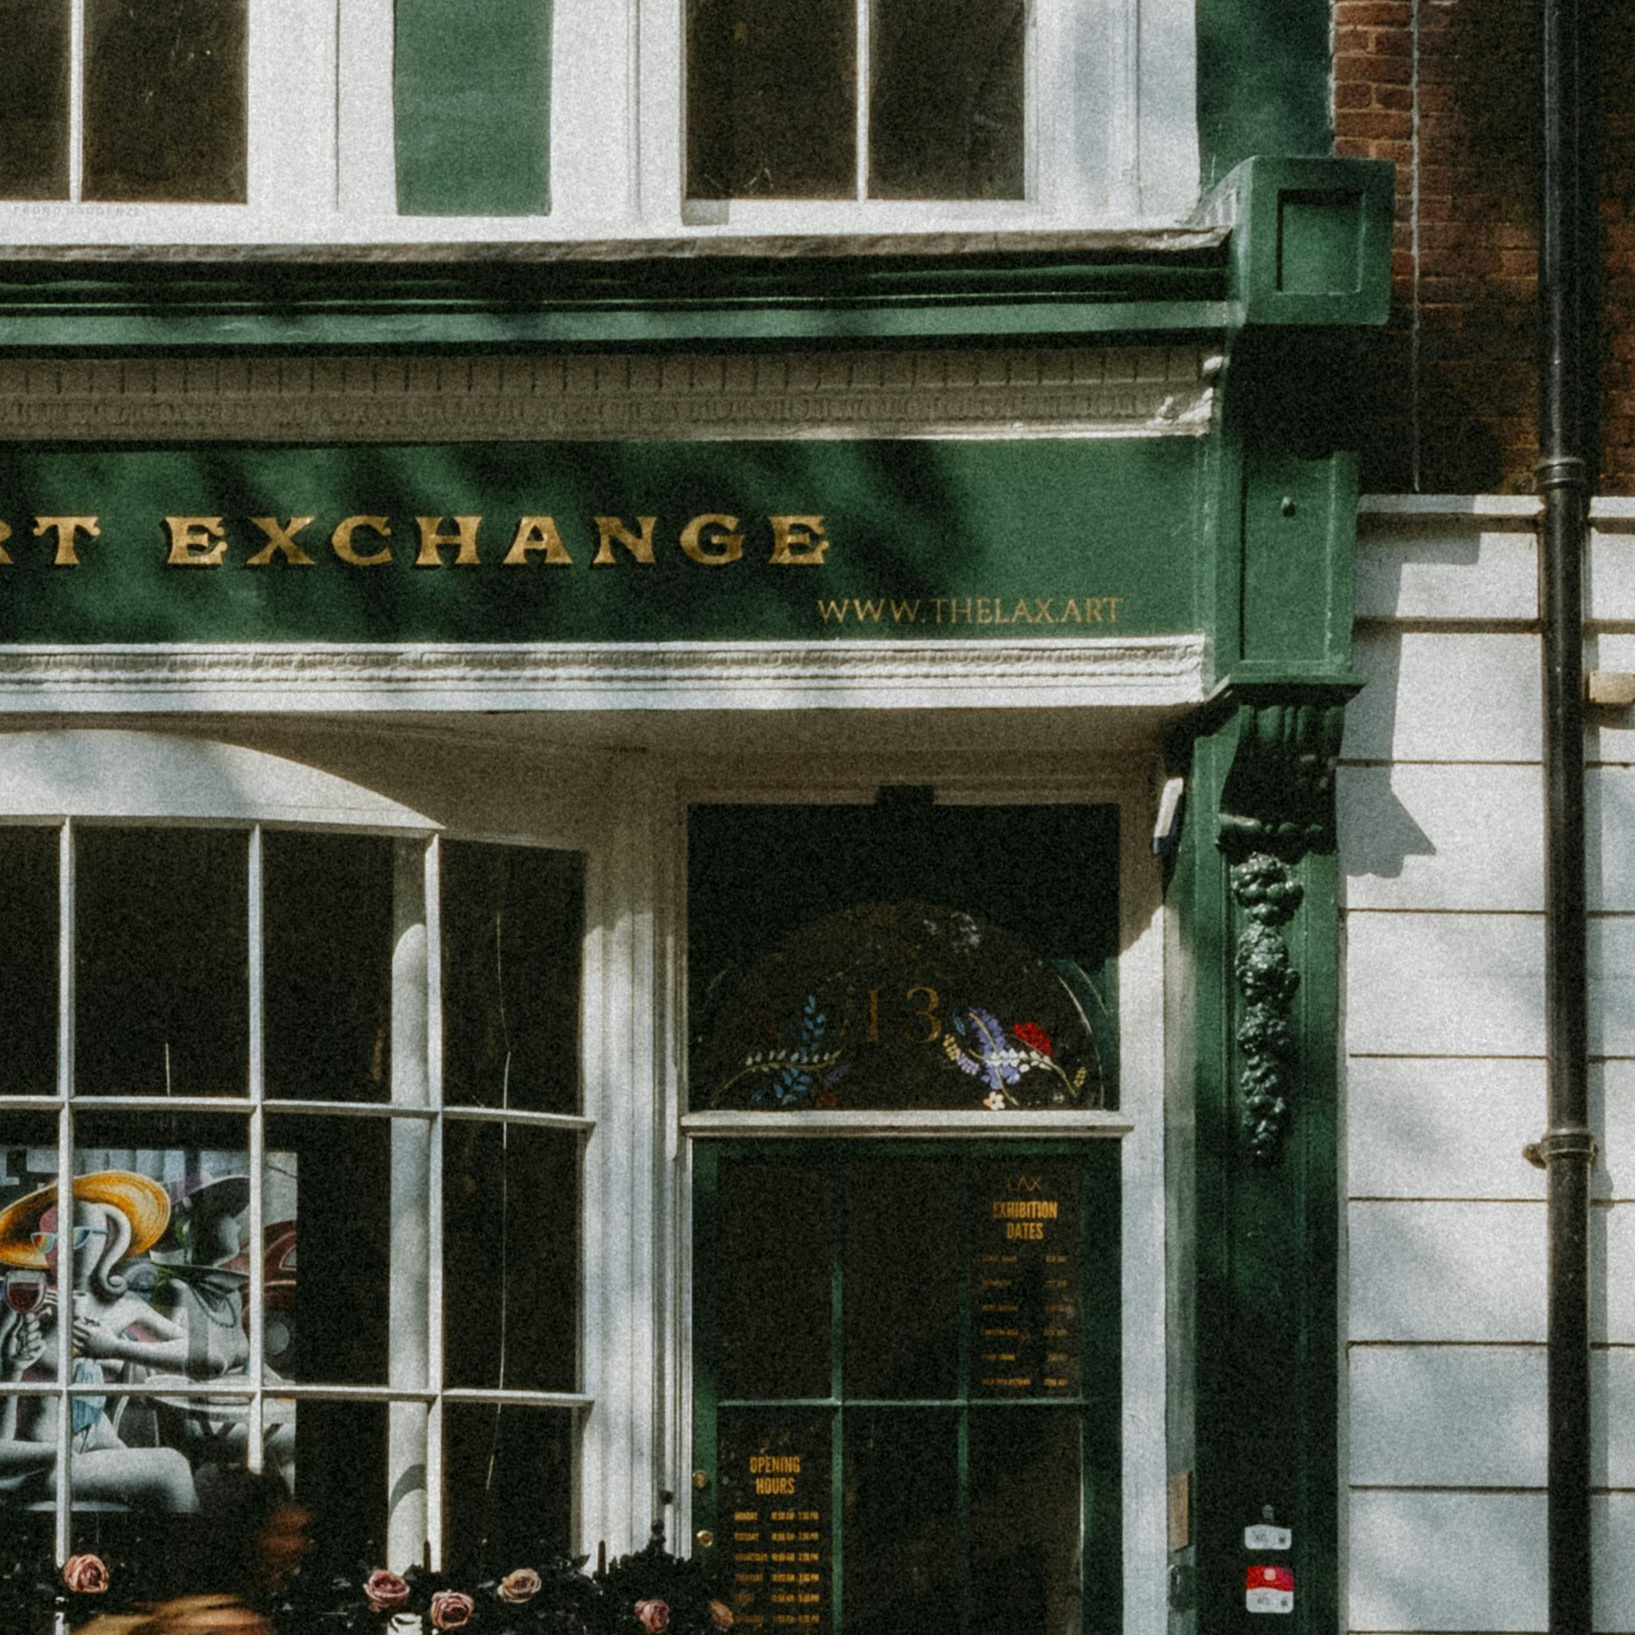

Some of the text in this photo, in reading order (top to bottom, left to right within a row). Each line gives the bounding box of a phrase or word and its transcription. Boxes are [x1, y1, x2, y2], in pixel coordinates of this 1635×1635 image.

[166, 513, 830, 566] EXCHANGE
[817, 597, 1123, 624] WWW.THELAX.ART
[868, 986, 941, 1043] 13
[993, 1200, 1058, 1219] EXHIBITION
[1006, 1222, 1044, 1240] DATES
[749, 1456, 801, 1474] OPENING
[755, 1477, 795, 1495] HOURS
